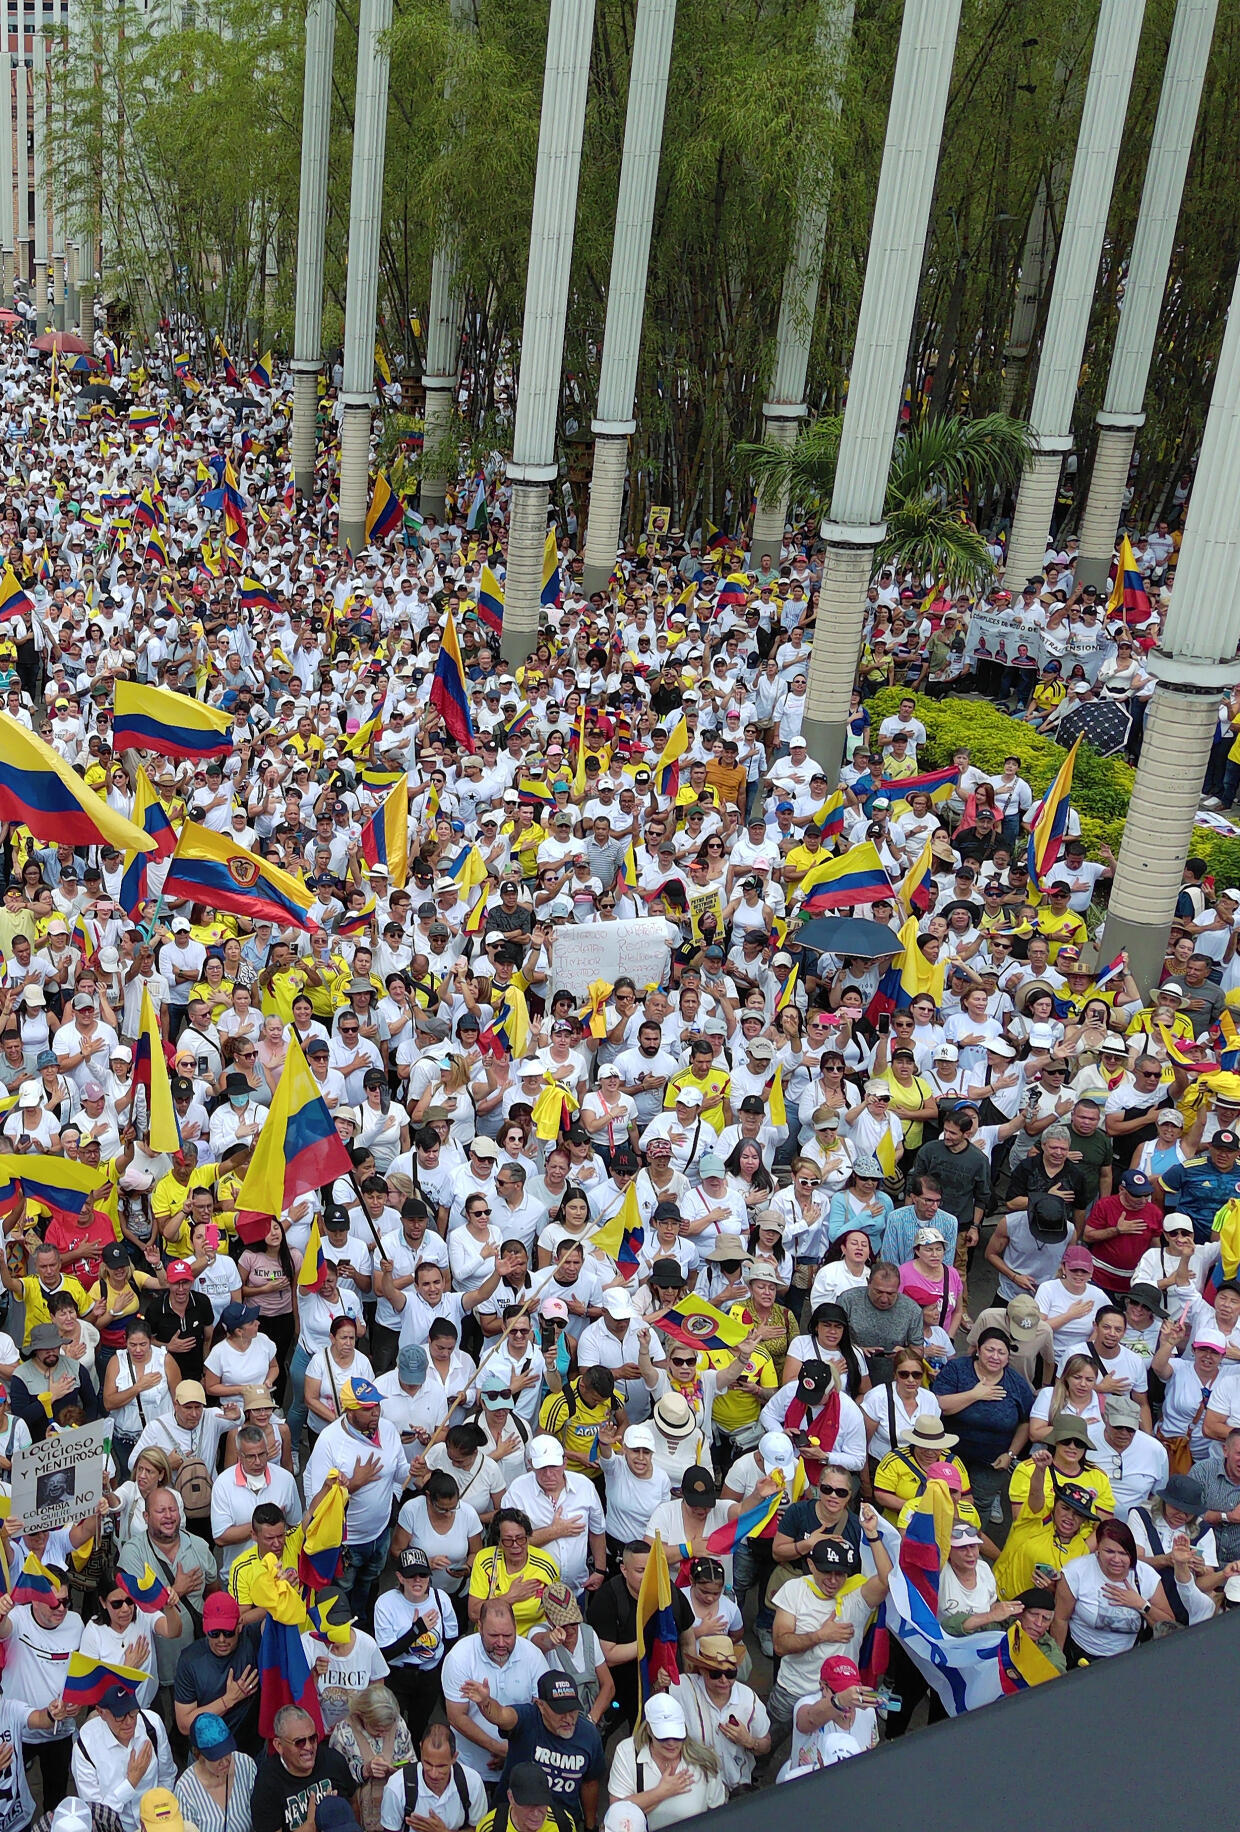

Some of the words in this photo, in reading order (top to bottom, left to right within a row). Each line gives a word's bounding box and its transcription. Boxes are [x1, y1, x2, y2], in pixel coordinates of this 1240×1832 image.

[20, 1469, 29, 1480] Y
[35, 1444, 104, 1476] MENTIROSO
[37, 1437, 94, 1463] VICIOSO
[23, 1501, 70, 1520] COLOMBIA
[75, 1490, 94, 1506] NO
[534, 1745, 585, 1771] TRUMP
